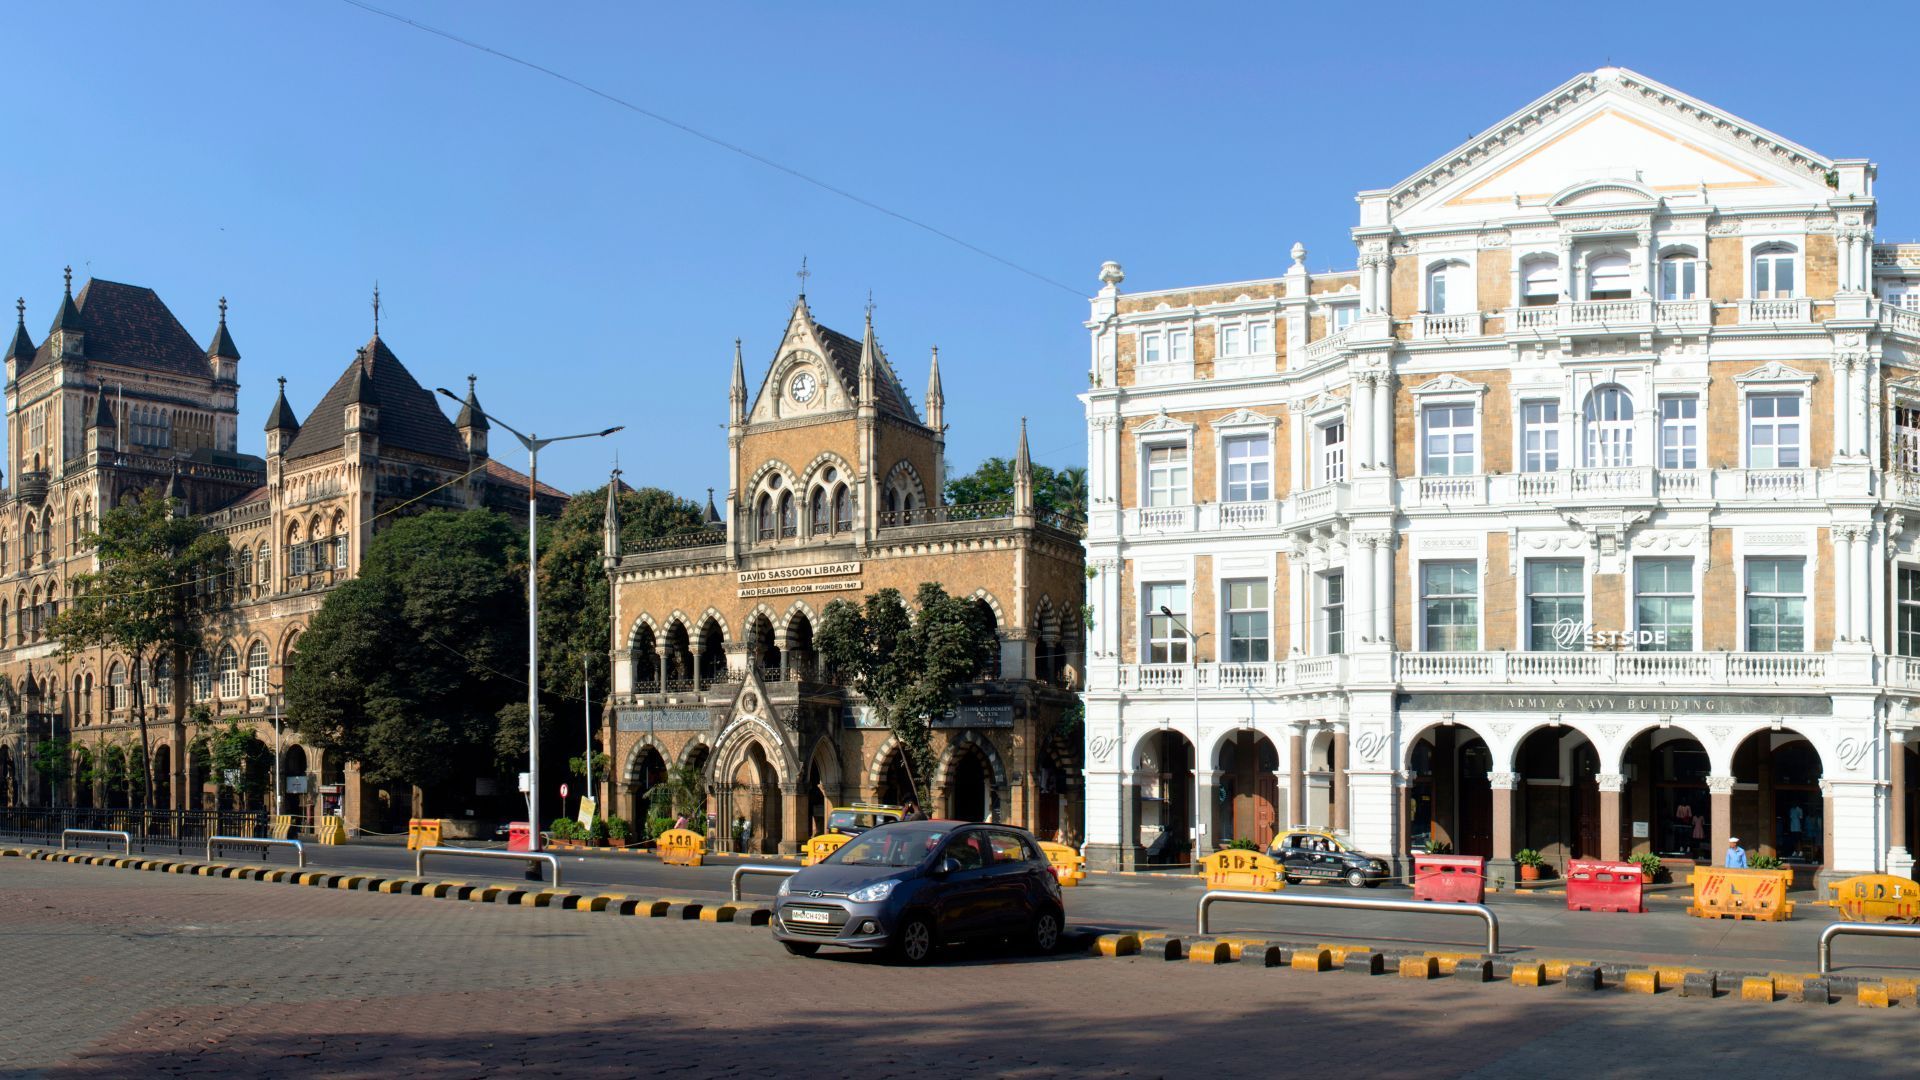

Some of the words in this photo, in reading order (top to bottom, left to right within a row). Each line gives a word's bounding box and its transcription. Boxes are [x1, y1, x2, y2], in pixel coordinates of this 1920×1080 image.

[740, 572, 766, 581] DAVID
[768, 567, 812, 579] SASSOON
[814, 564, 856, 575] LIBRARY
[741, 589, 756, 597] AND
[757, 587, 789, 595] READING
[815, 583, 843, 591] FOUNDED
[1552, 618, 1665, 649] WESTSIDE
[1507, 698, 1547, 709] ARMY
[1556, 698, 1565, 709] &
[1576, 698, 1616, 709] NAVY
[1628, 698, 1715, 711] BUILDING
